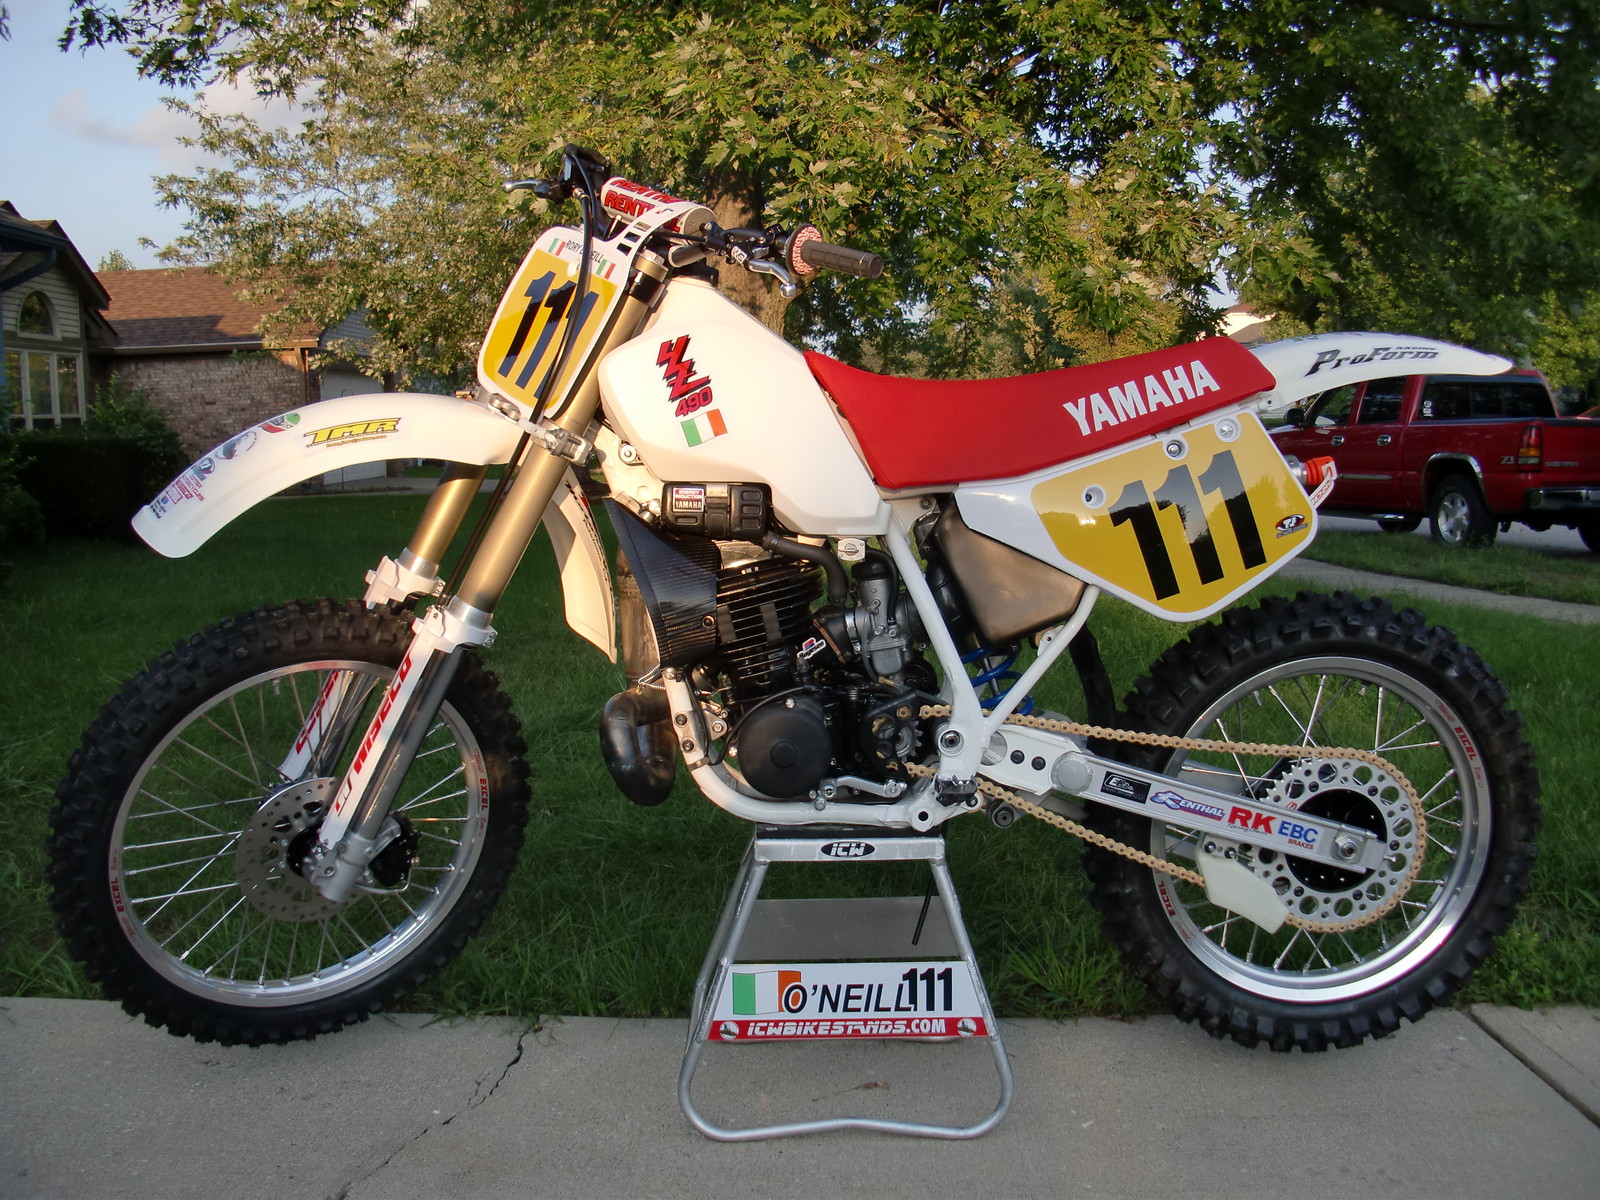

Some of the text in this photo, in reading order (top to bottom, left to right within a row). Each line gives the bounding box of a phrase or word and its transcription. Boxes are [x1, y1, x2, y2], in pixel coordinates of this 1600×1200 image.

[497, 270, 600, 399] 111
[1303, 347, 1439, 377] ProForm
[675, 386, 713, 417] 490
[1062, 360, 1221, 436] YAMAHA
[675, 501, 702, 509] YAMAHA
[1107, 449, 1267, 601] 111
[1454, 727, 1477, 760] EXCEL
[480, 778, 488, 811] EXCEL
[1227, 806, 1277, 835] RK
[1277, 820, 1319, 844] EBC
[1287, 838, 1315, 851] BRAKES
[112, 877, 125, 912] EXCEL
[1157, 880, 1176, 917] EXCEL
[783, 967, 953, 1014] O'NEILL 111
